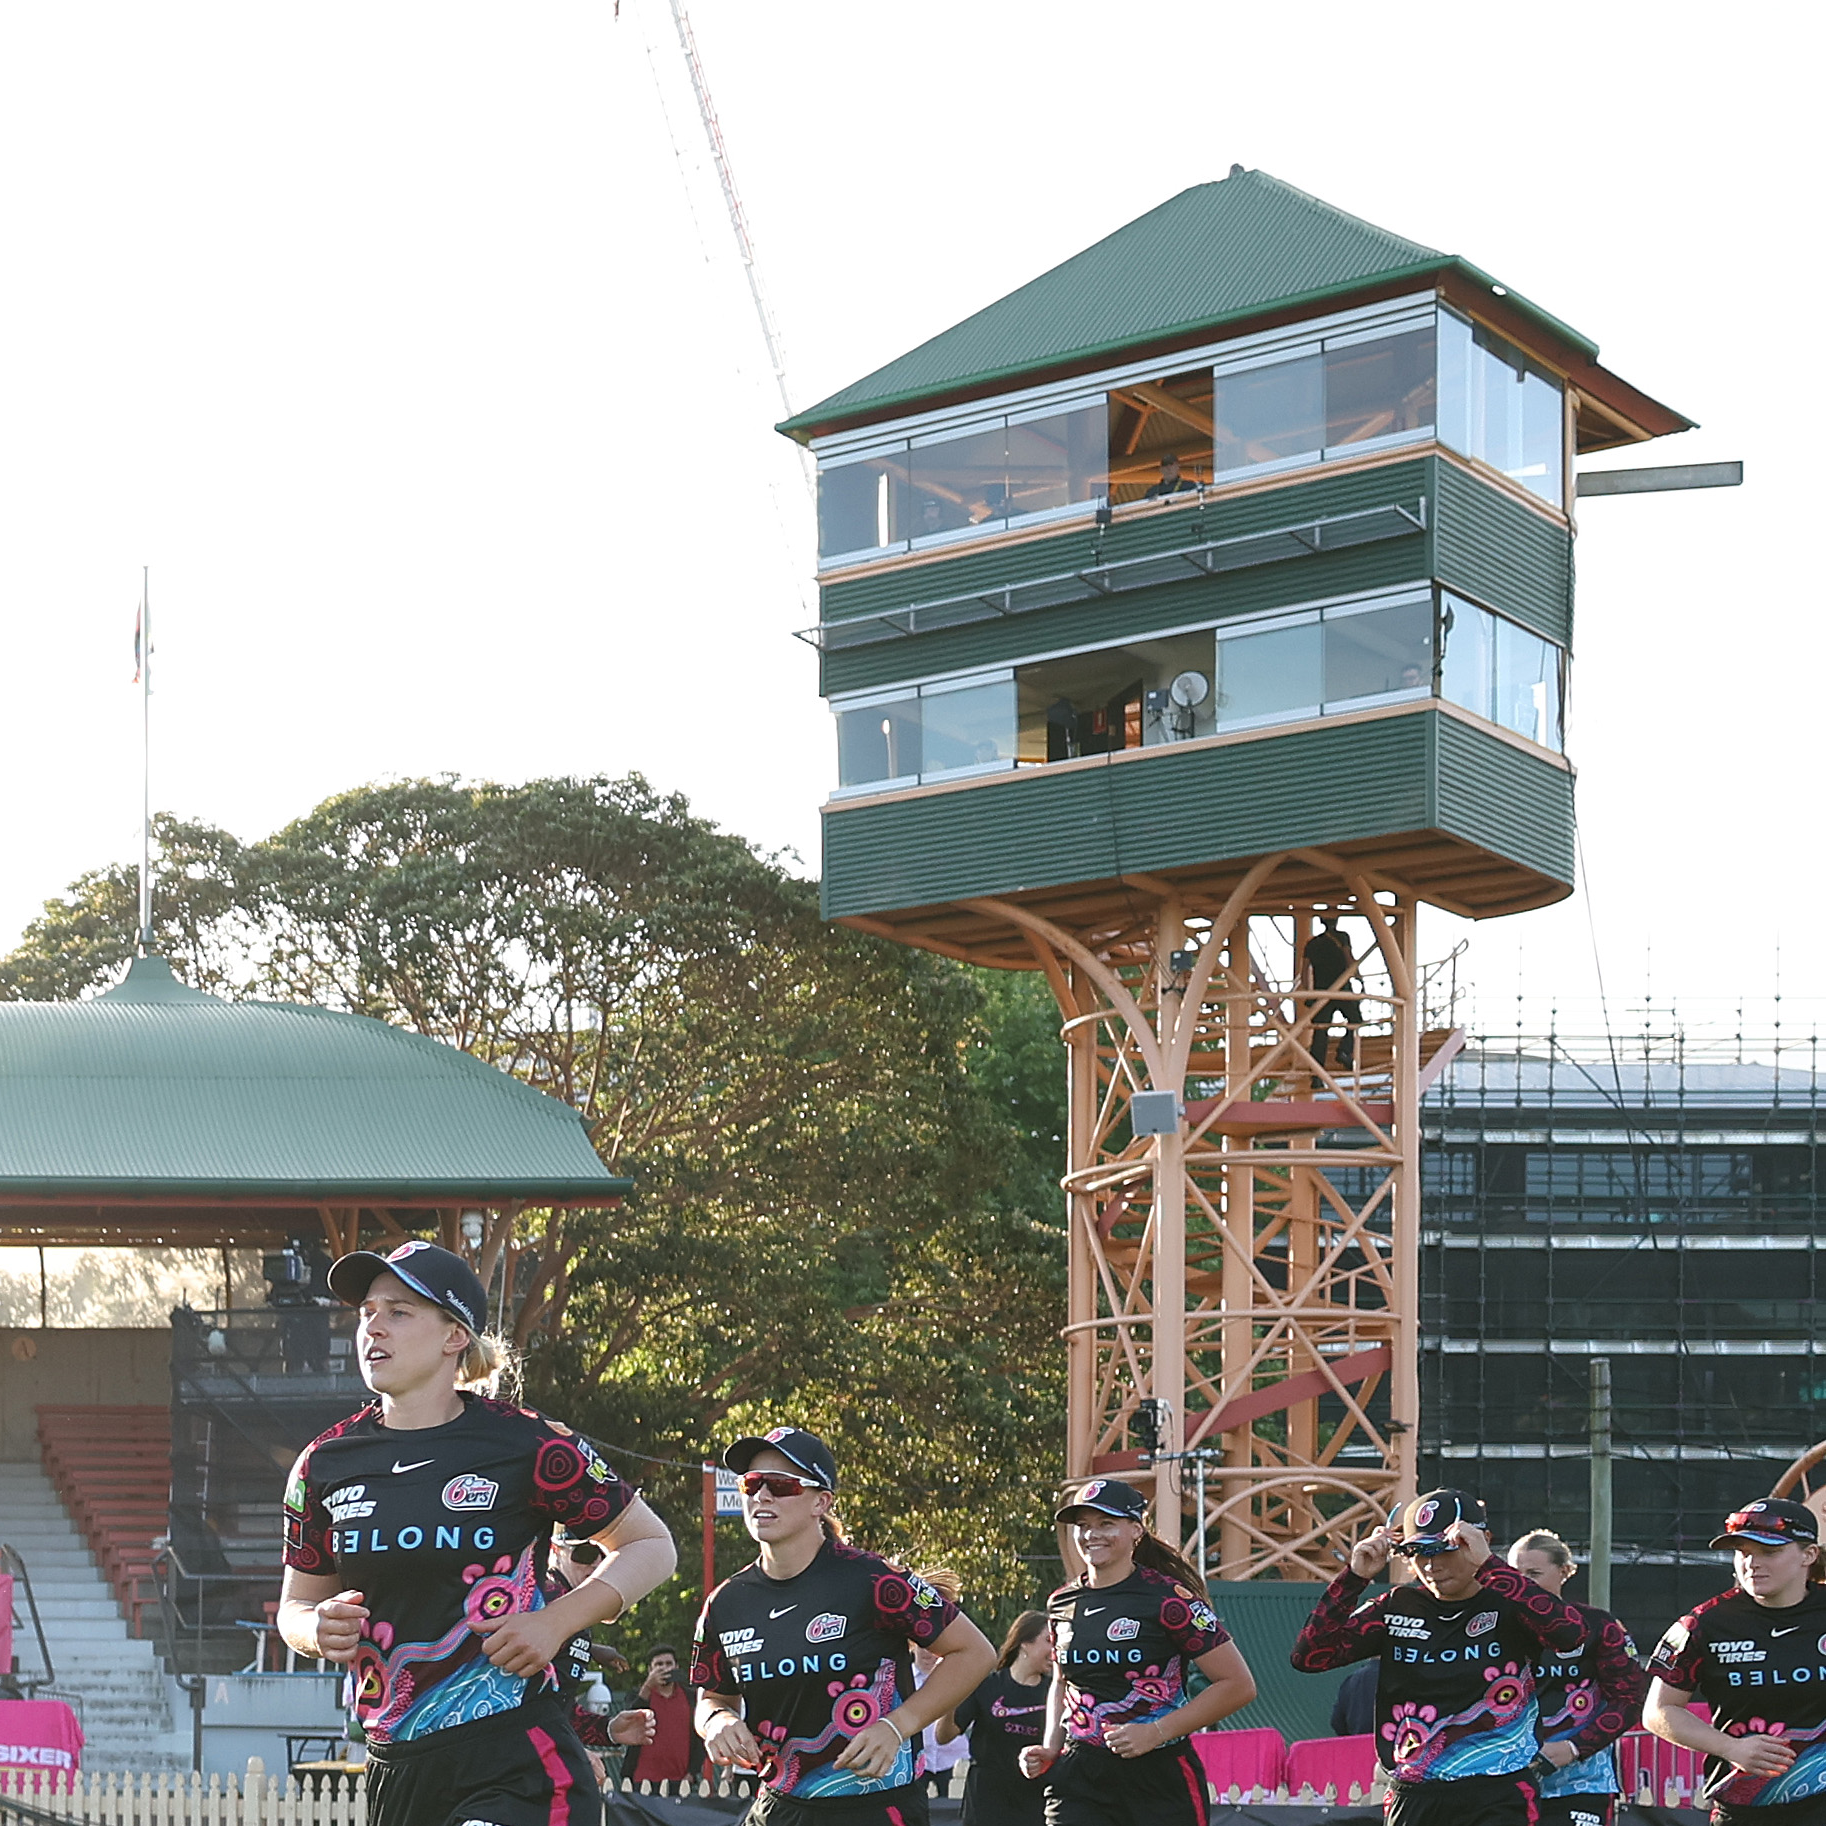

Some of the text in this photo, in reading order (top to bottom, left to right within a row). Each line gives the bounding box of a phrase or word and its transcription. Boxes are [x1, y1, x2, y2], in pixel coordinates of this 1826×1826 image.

[1384, 1614, 1425, 1629] TOYO
[1388, 1626, 1432, 1641] TIRES
[1709, 1640, 1755, 1654] TOYO
[1717, 1650, 1767, 1664] TIRES
[1569, 1810, 1601, 1825] TOYO
